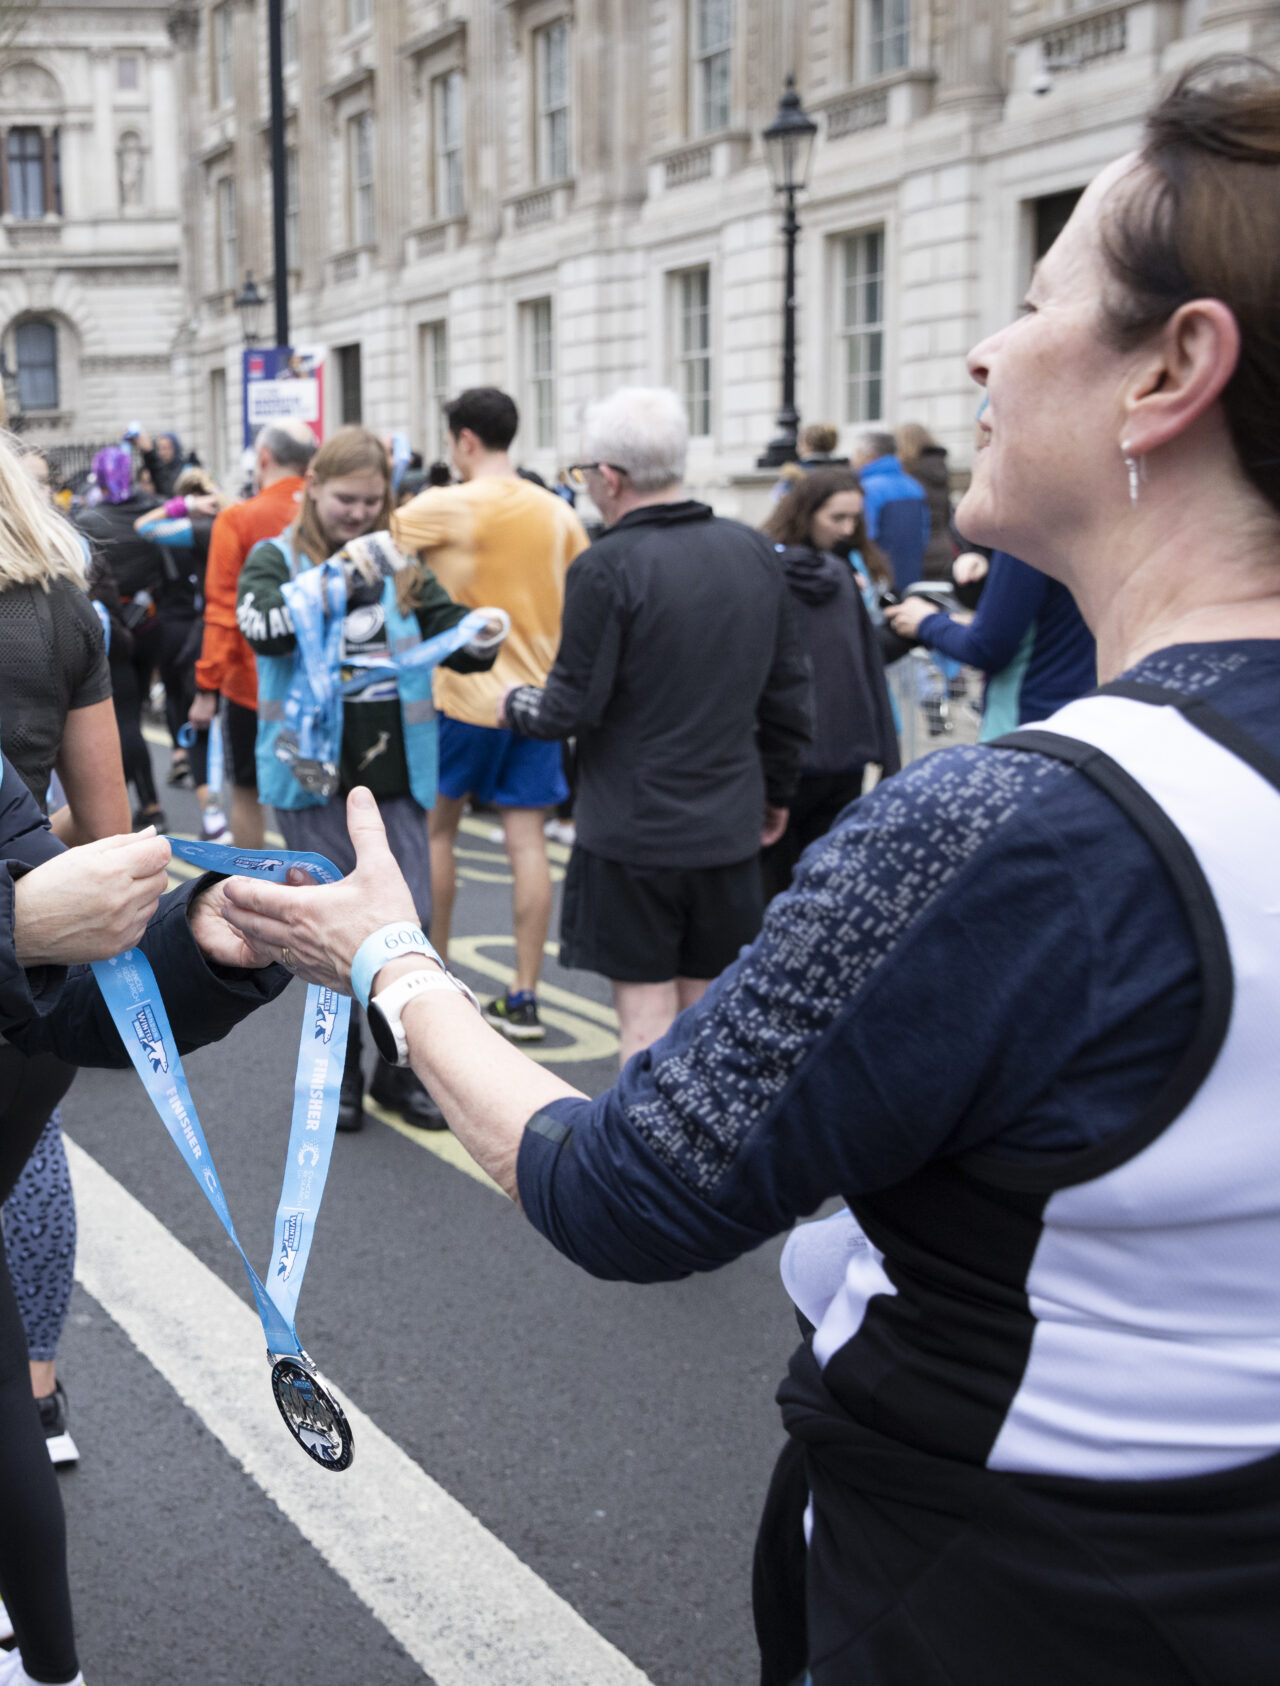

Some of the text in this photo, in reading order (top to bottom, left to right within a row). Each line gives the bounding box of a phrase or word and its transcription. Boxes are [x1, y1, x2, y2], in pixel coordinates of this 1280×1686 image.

[137, 1011, 153, 1042] WINTER
[167, 1086, 202, 1159] FINISHER
[305, 1058, 329, 1131] FINISHER
